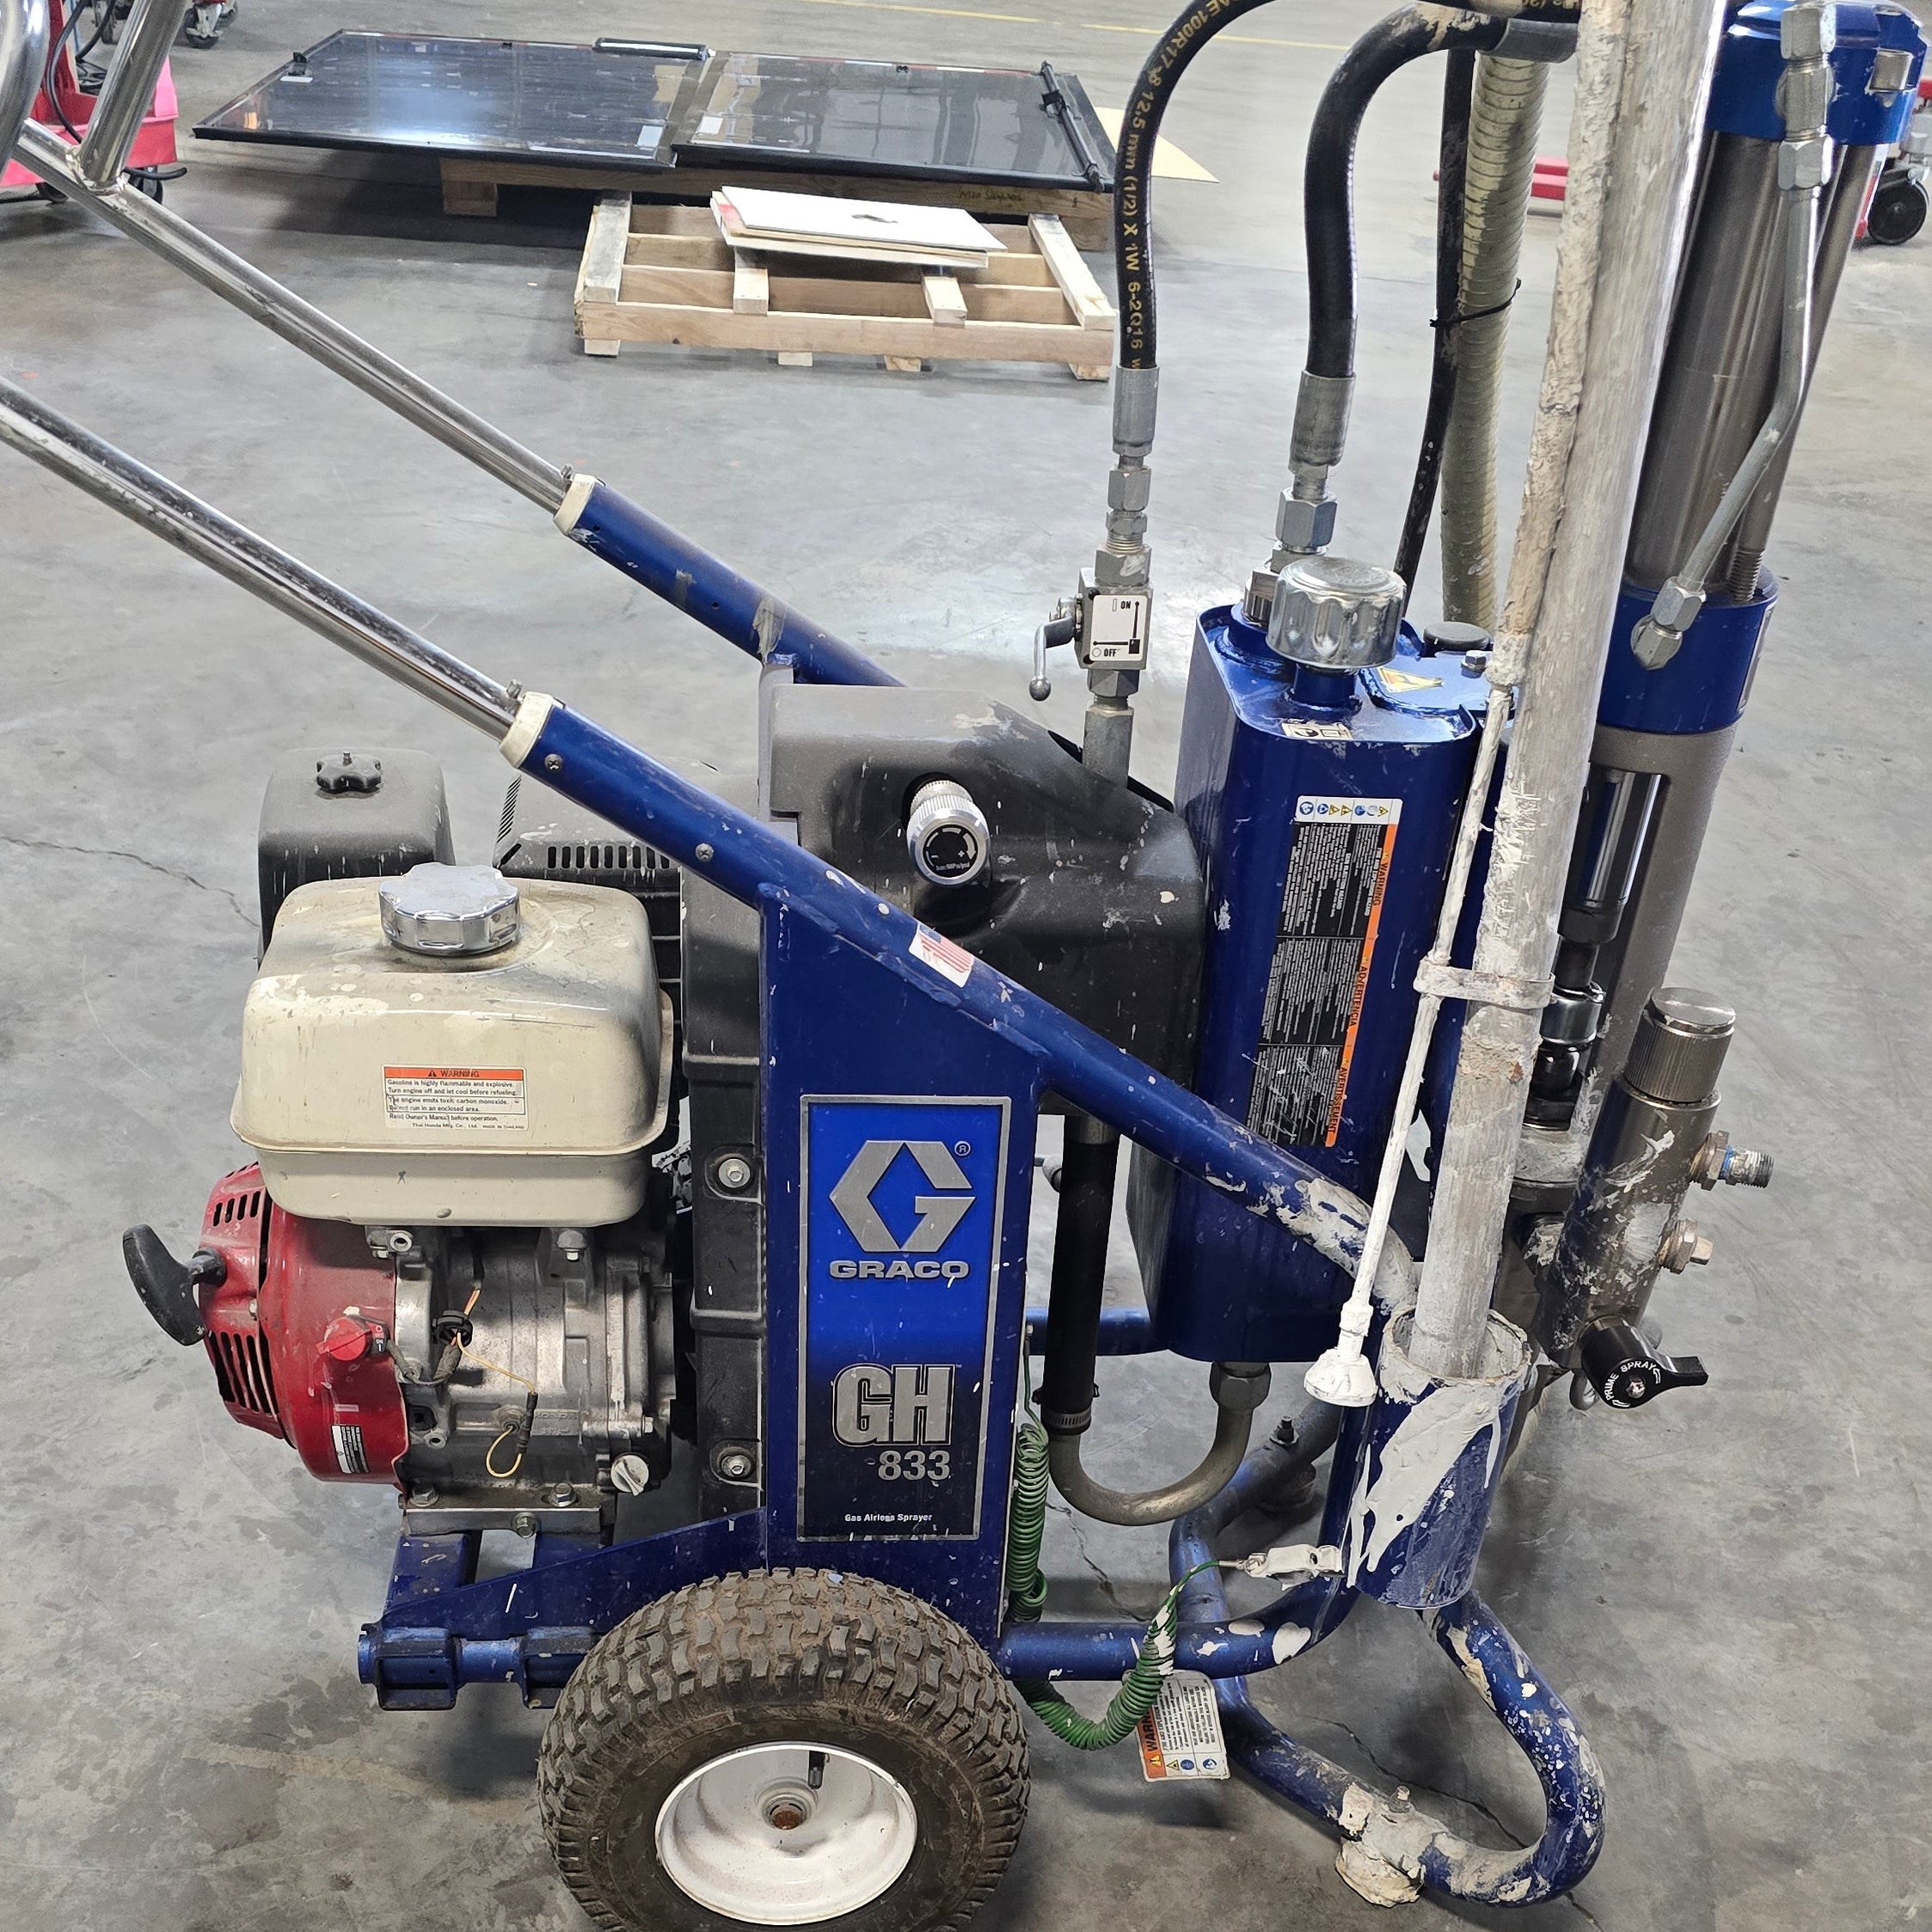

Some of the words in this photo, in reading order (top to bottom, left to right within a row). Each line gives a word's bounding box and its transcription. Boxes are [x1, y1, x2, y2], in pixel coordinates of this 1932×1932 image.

[1125, 133, 1139, 169] mm
[1123, 175, 1138, 216] (1/2)
[1125, 244, 1140, 271] 1W
[1103, 648, 1117, 657] OFF
[1372, 862, 1389, 905] WARNING
[1349, 966, 1368, 1027] ADVERTENCIA
[1328, 1067, 1347, 1133] AVERTISSEMENT
[830, 1260, 970, 1279] GRACO
[1620, 1361, 1657, 1372] SPRAY
[1604, 1372, 1619, 1401] PRIME
[832, 1363, 955, 1447] GH
[878, 1451, 950, 1481] 833
[844, 1513, 862, 1522] Gas
[897, 1513, 933, 1523] Sprayer
